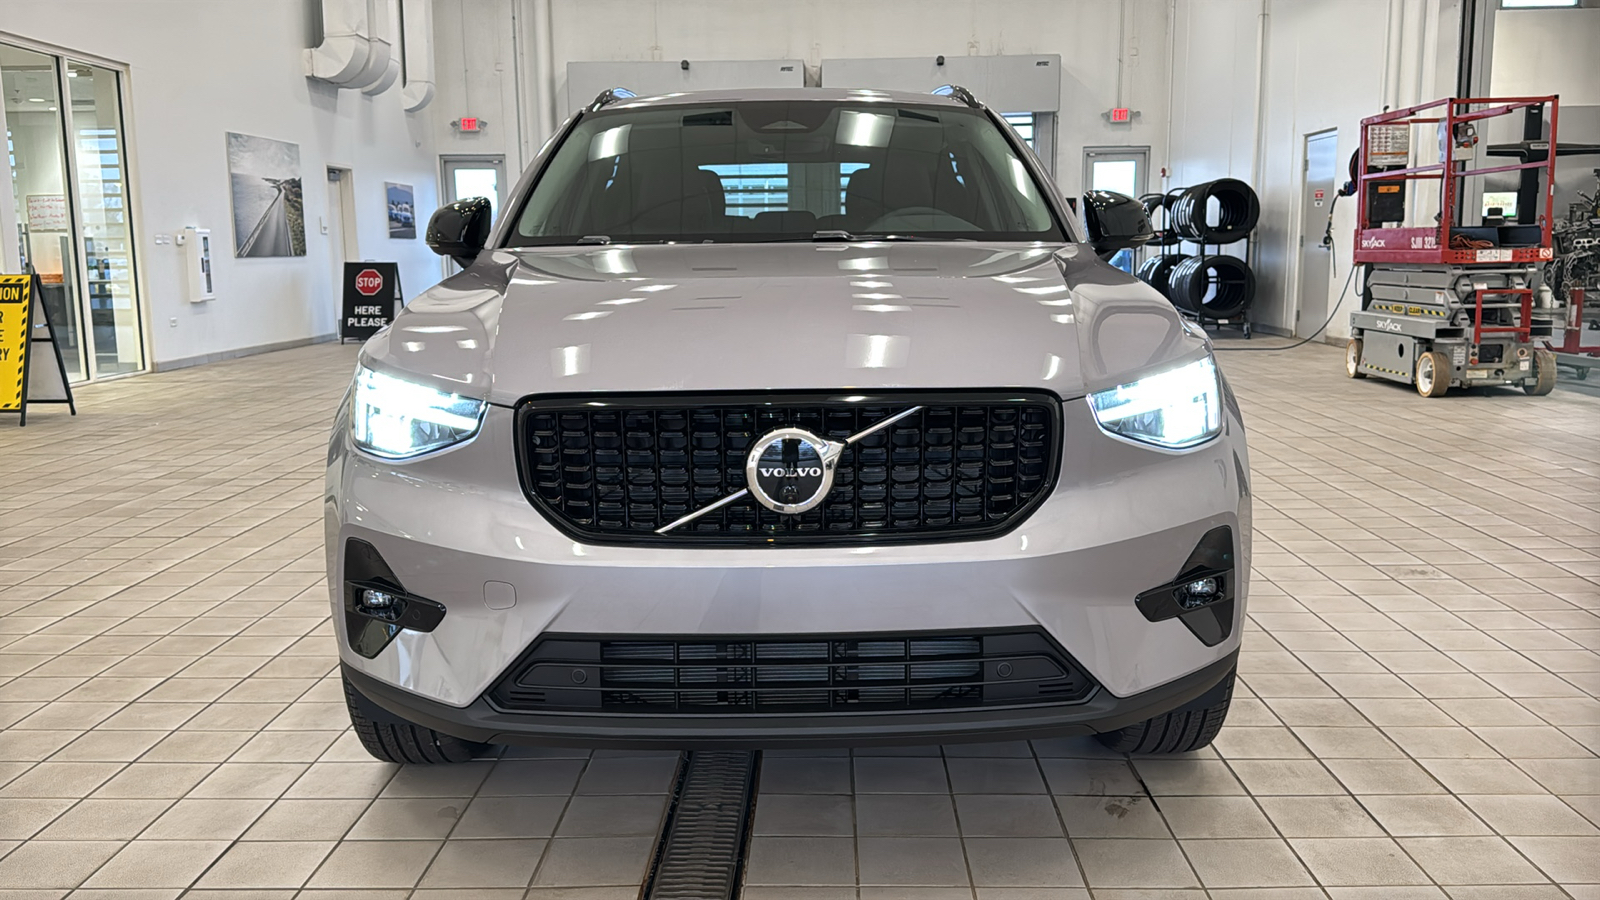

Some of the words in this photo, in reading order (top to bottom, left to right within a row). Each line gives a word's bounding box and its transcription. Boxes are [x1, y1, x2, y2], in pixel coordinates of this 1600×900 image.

[1112, 108, 1128, 121] EXIT
[461, 117, 477, 130] EXIT
[1361, 236, 1386, 249] SKYJACK
[357, 277, 381, 288] STOP
[354, 305, 382, 315] HERE
[347, 317, 388, 327] PLEASE
[1376, 319, 1402, 332] SKYJACK
[759, 467, 822, 477] VOLVO
